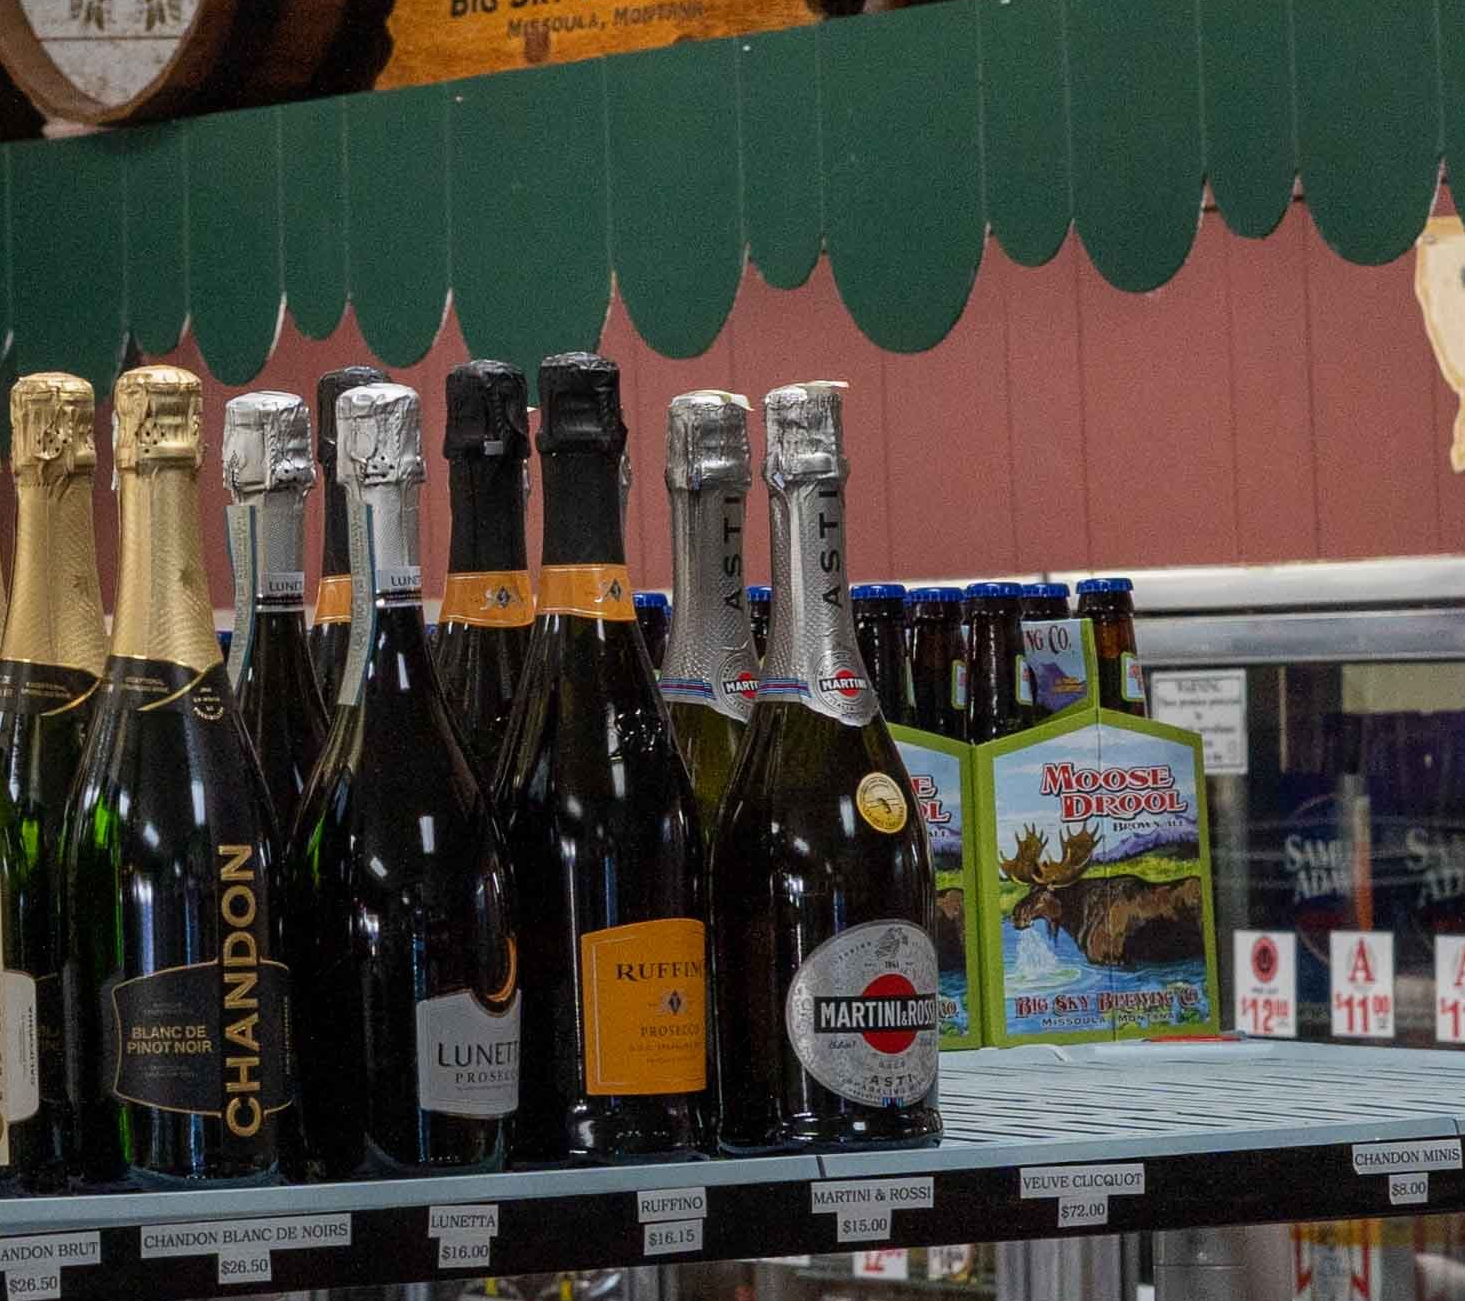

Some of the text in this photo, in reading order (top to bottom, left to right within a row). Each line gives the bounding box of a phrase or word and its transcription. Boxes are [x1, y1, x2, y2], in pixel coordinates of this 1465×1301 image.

[723, 495, 744, 613] ASTI
[1040, 762, 1175, 796] MOOSE
[1060, 790, 1188, 824] DROOL
[219, 844, 263, 1138] CHANDON
[1015, 997, 1049, 1019] BIG
[1053, 995, 1091, 1015] SKY
[1097, 990, 1172, 1013] BREWING
[132, 1026, 207, 1040] BLANC DE
[127, 1040, 213, 1055] PINOT NOIR
[868, 1072, 914, 1088] ASTI
[1354, 1143, 1461, 1167] CHANDON MINIS
[1023, 1167, 1143, 1191] VEUVE CLICQUOT
[1392, 1179, 1428, 1199] $8.00
[641, 1195, 703, 1214] RUFFINO
[813, 1183, 933, 1207] MARTINI & ROSSI
[430, 1212, 497, 1231] LUNETTA
[1060, 1202, 1107, 1222] $72.00
[143, 1221, 349, 1250] CHANDON BLANC DE NOIRS
[842, 1216, 888, 1235] $15.00
[649, 1228, 696, 1248] $16.15
[51, 1241, 99, 1260] BRUT
[441, 1242, 489, 1262] $16.00
[221, 1257, 269, 1277] $26.50
[9, 1275, 59, 1295] $26.50
